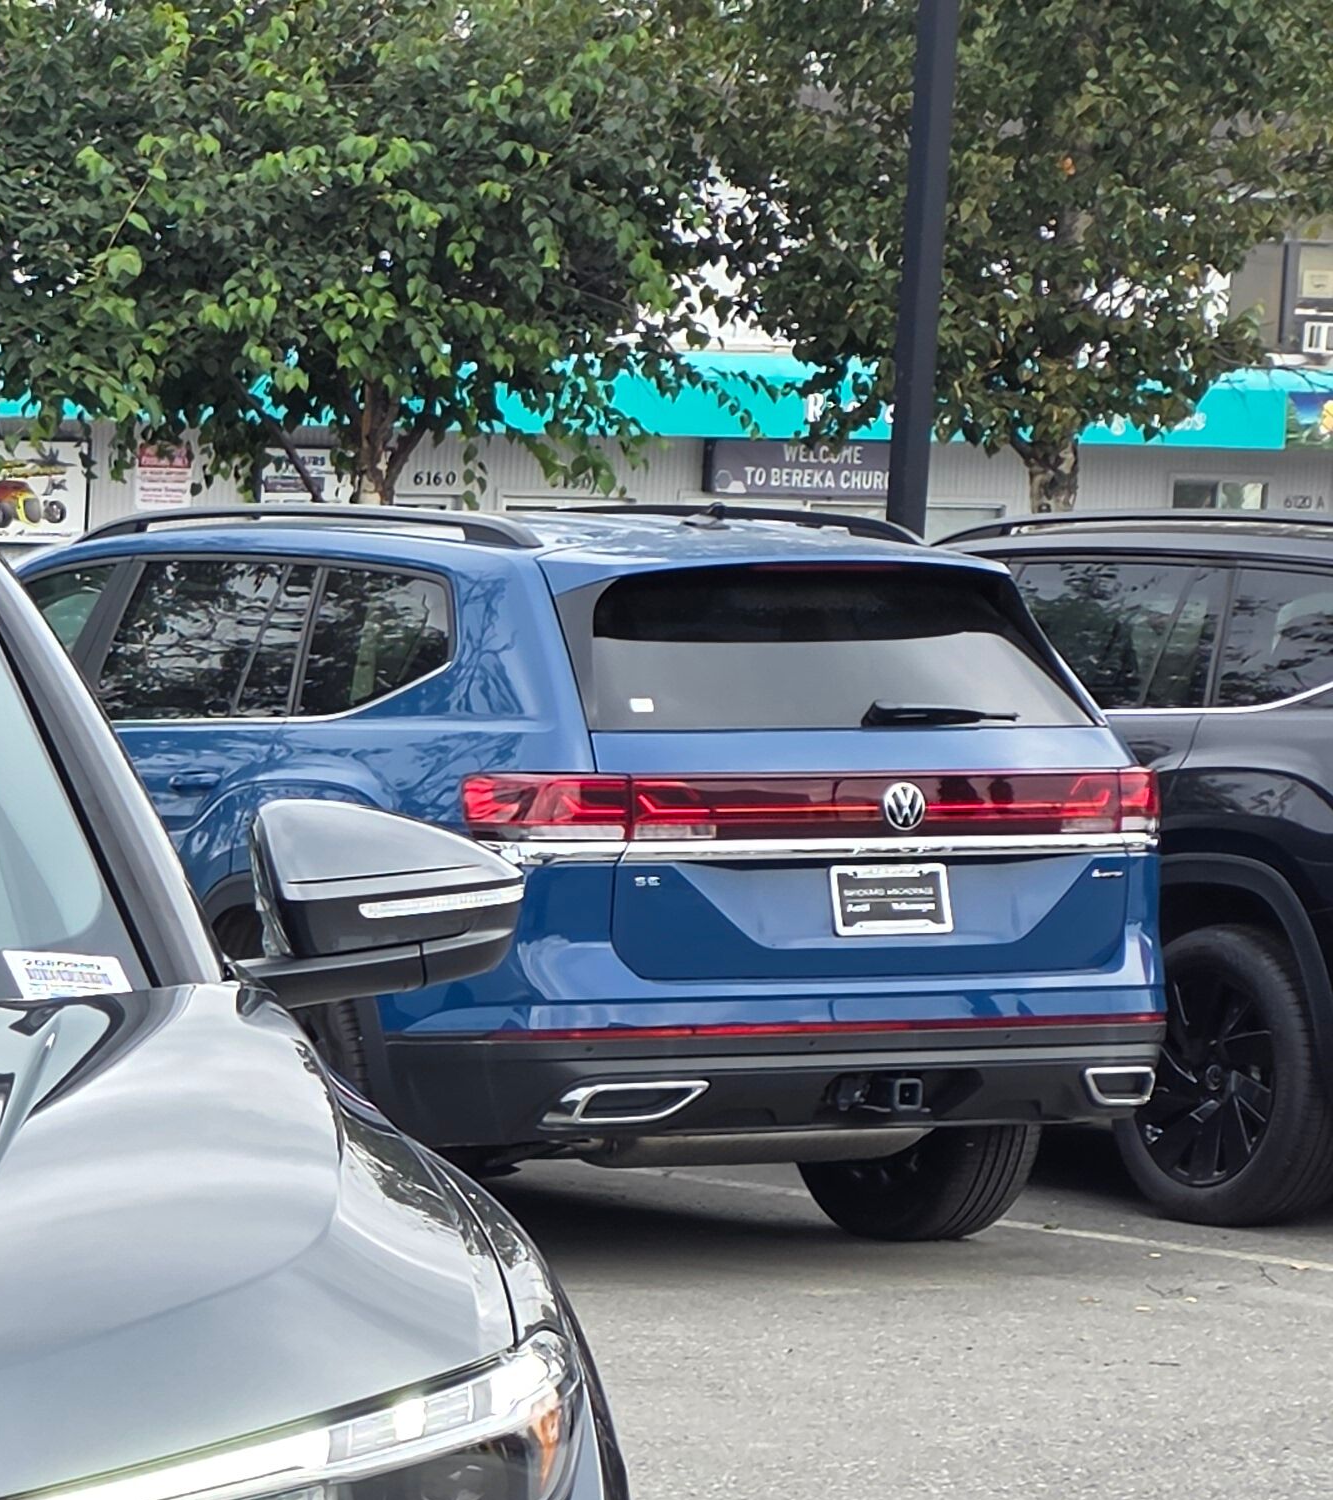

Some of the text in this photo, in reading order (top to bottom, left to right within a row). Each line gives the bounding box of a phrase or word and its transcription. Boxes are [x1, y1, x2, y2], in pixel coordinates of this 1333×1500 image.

[413, 471, 457, 487] 6160
[744, 466, 767, 486] TO
[770, 467, 835, 488] BEREKA
